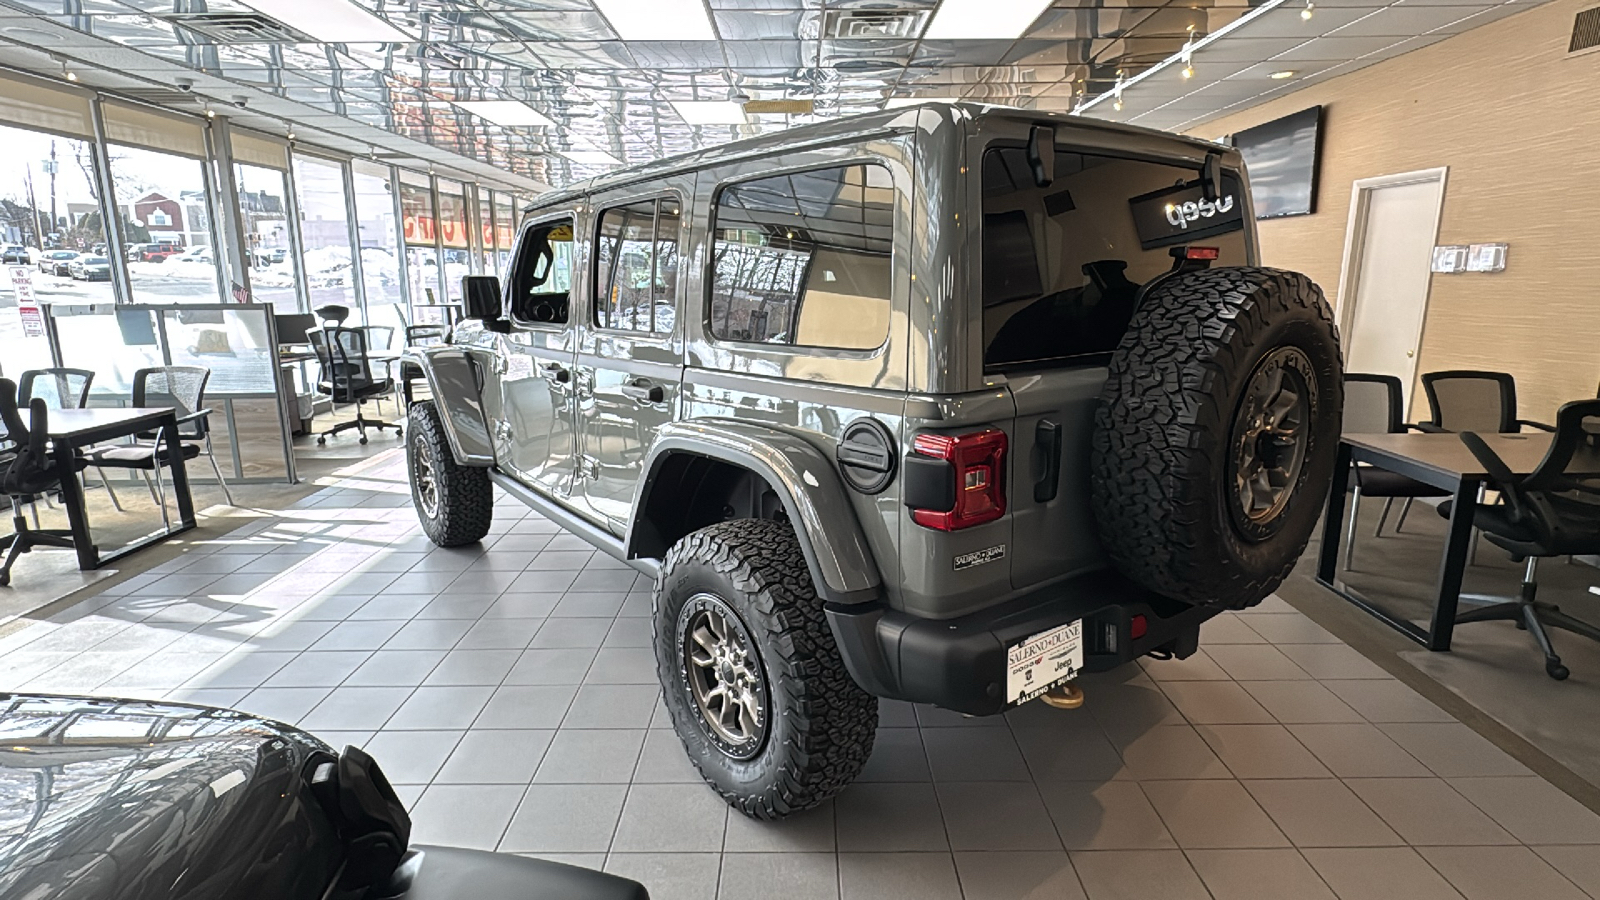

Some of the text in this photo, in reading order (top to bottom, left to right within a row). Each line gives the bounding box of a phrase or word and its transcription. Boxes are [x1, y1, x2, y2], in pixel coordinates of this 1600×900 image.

[1009, 639, 1048, 665] SALERNO
[1052, 625, 1080, 647] DUANE
[1055, 658, 1072, 672] Jeep
[1017, 671, 1078, 706] SALERNO DUANE
